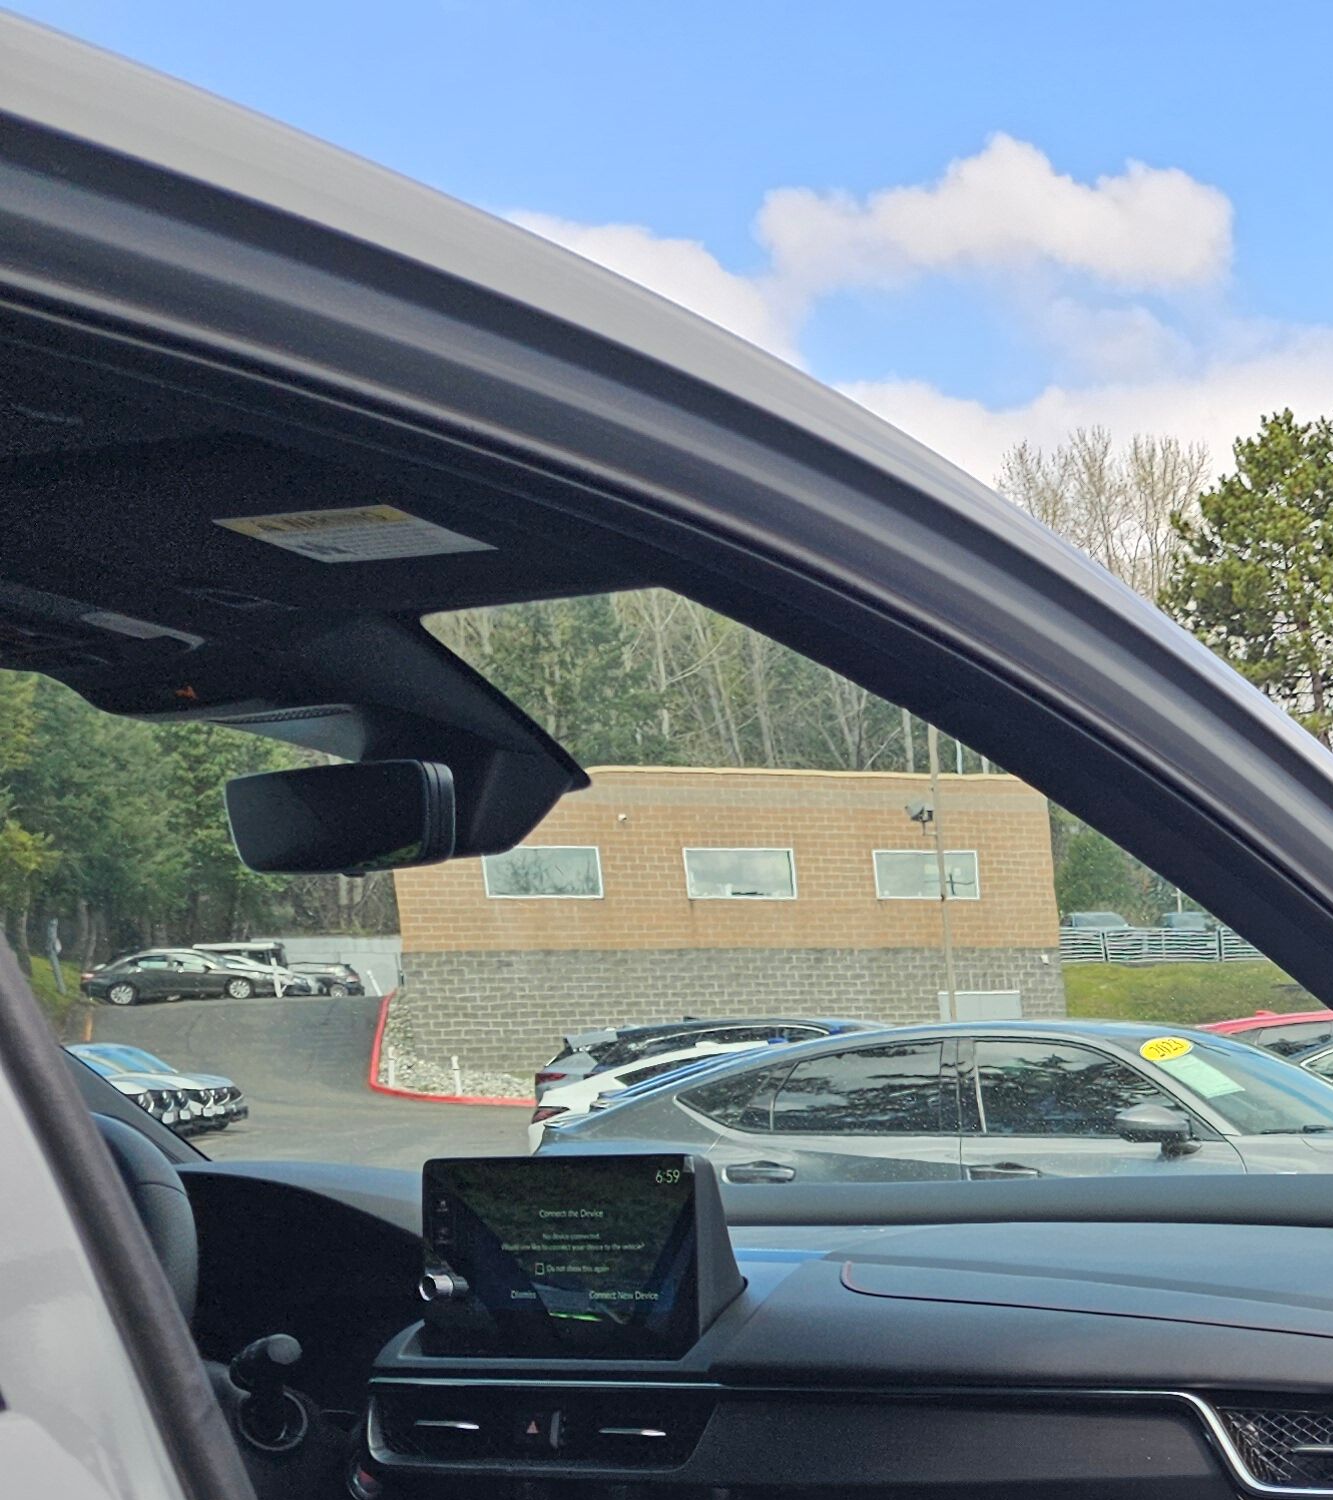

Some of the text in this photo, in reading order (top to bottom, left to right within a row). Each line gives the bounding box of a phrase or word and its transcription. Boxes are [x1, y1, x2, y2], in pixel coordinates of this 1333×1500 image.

[1149, 1039, 1184, 1057] 2023
[655, 1169, 680, 1183] 6:59
[581, 1209, 603, 1218] Device
[635, 1290, 659, 1300] Device
